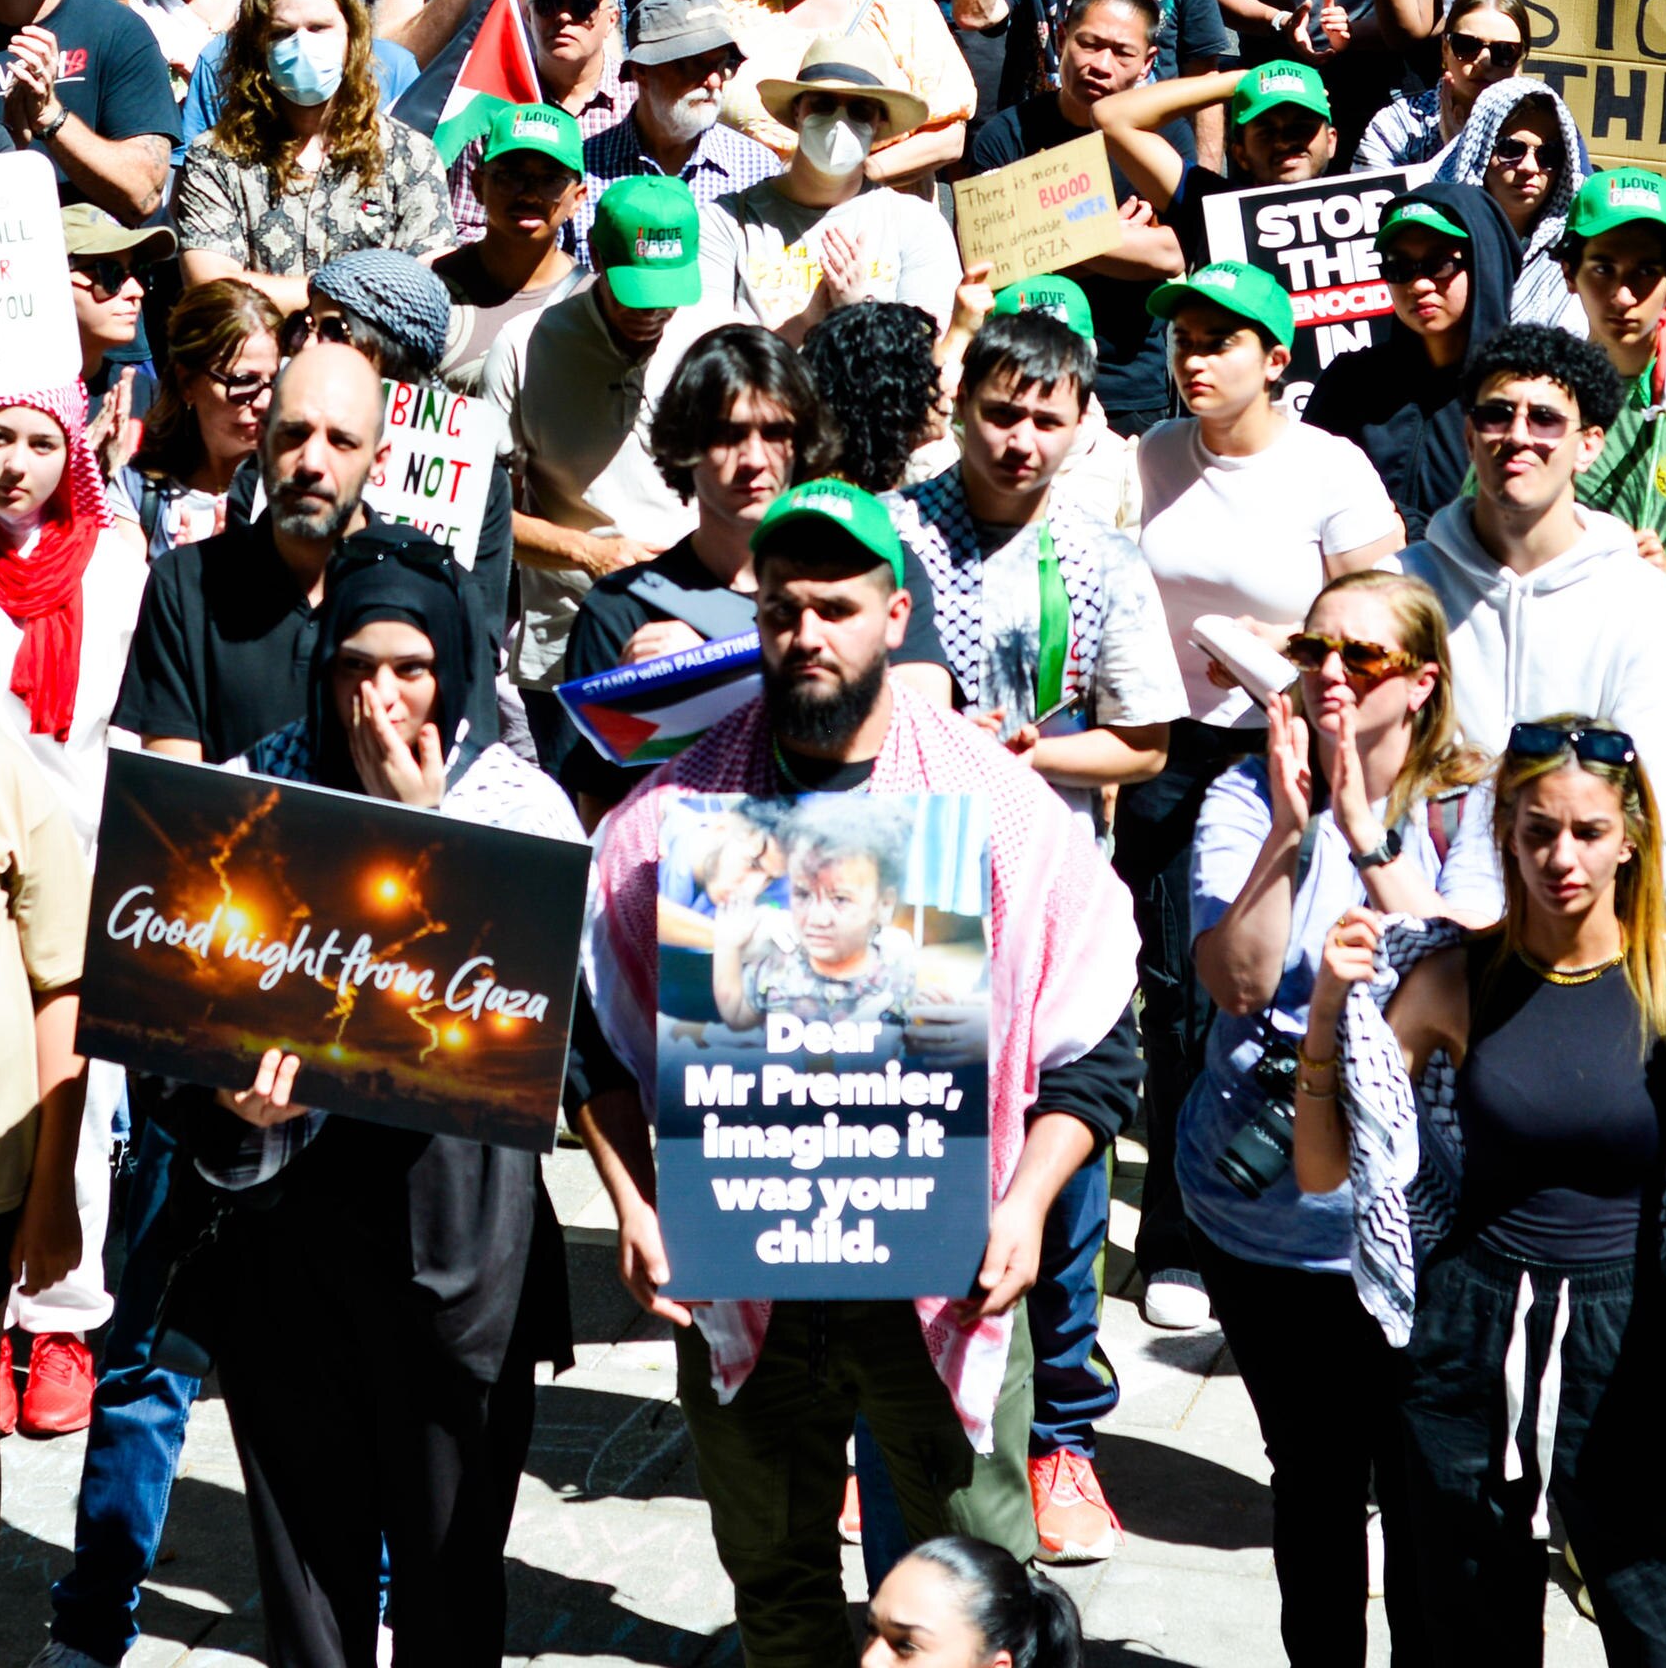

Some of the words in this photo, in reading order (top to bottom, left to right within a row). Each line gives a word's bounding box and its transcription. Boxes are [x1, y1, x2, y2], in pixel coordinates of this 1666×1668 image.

[1268, 68, 1302, 80] LOVE
[524, 112, 560, 128] LOVE
[961, 182, 1006, 208] There
[1014, 176, 1026, 192] is
[1032, 161, 1070, 188] more
[973, 209, 1016, 236] spilled
[1038, 173, 1092, 210] BLOOD
[1621, 178, 1659, 194] LOVE
[649, 226, 681, 240] LOVE
[972, 235, 1005, 258] than
[1008, 219, 1062, 248] drinkable
[1065, 195, 1109, 224] WATER
[1256, 189, 1396, 248] STOP
[636, 239, 683, 257] GAZA
[993, 258, 1011, 276] in
[1024, 240, 1071, 269] GAZA
[1278, 236, 1383, 292] THE
[1031, 290, 1066, 305] LOVE
[1292, 281, 1394, 322] ENOCID
[1315, 319, 1373, 370] IN
[402, 451, 471, 503] NOT
[583, 669, 636, 695] STAND
[638, 661, 672, 686] with
[673, 631, 761, 676] PALESTINE
[107, 884, 217, 949] Good
[224, 915, 342, 994] night
[339, 946, 435, 1003] from
[446, 956, 549, 1022] Gaza
[766, 1012, 883, 1058] Dear
[684, 1065, 757, 1108] Mr
[761, 1061, 964, 1113] Premier,
[703, 1115, 898, 1170] imagine
[907, 1115, 944, 1159] it
[712, 1176, 819, 1213] was
[819, 1171, 935, 1222] your
[755, 1218, 891, 1265] child.
